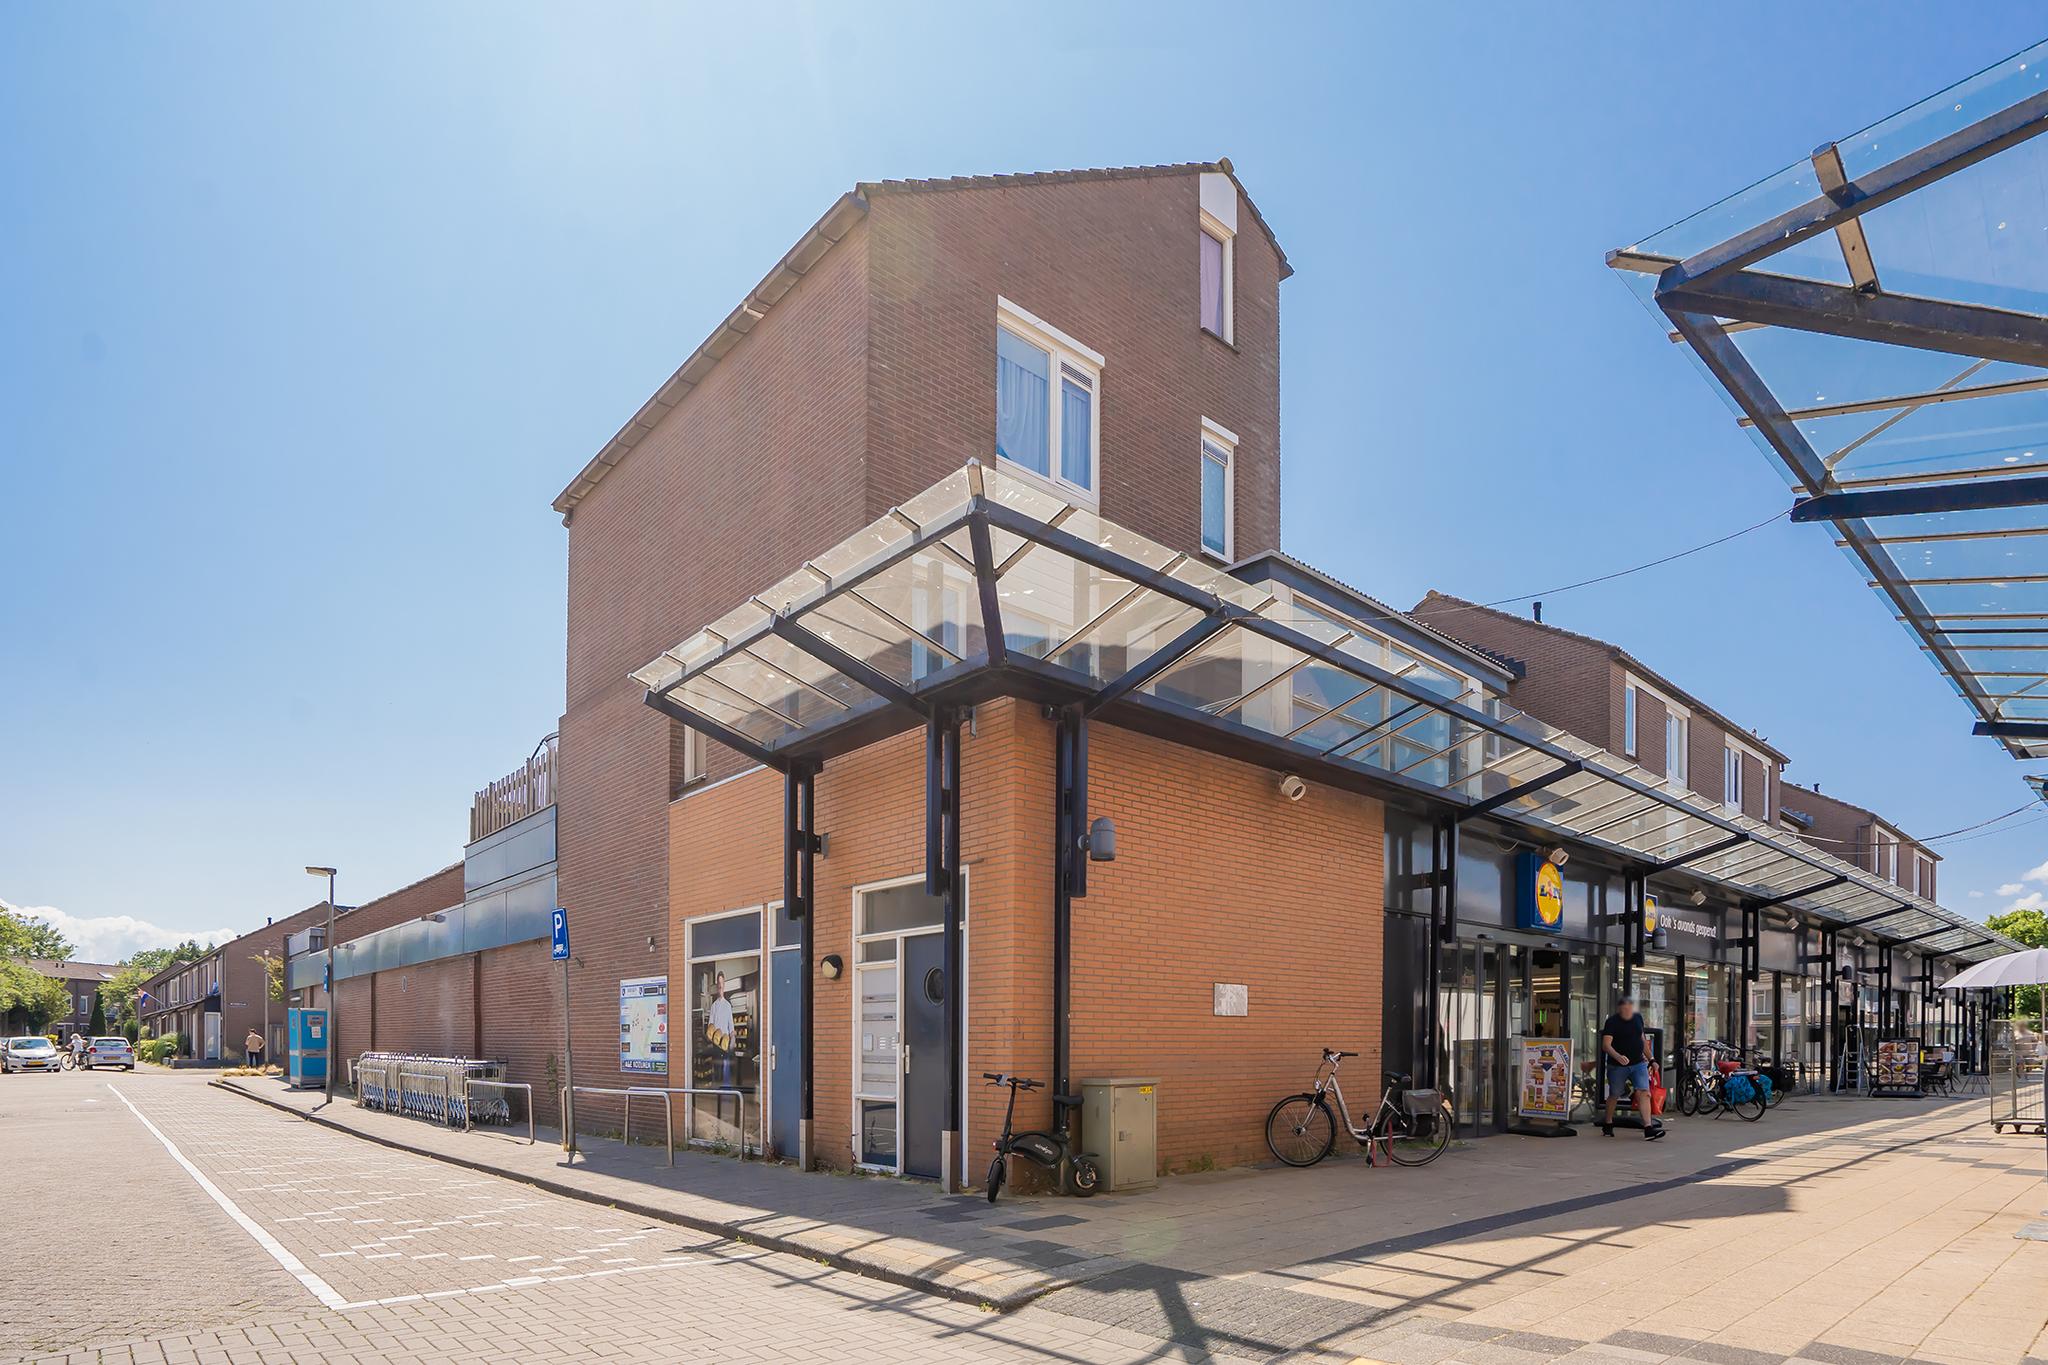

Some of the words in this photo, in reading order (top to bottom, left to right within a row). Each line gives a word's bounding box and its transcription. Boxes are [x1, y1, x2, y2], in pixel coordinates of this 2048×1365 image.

[554, 913, 563, 939] P
[1660, 914, 1672, 929] Ook
[1677, 920, 1696, 933] avonds
